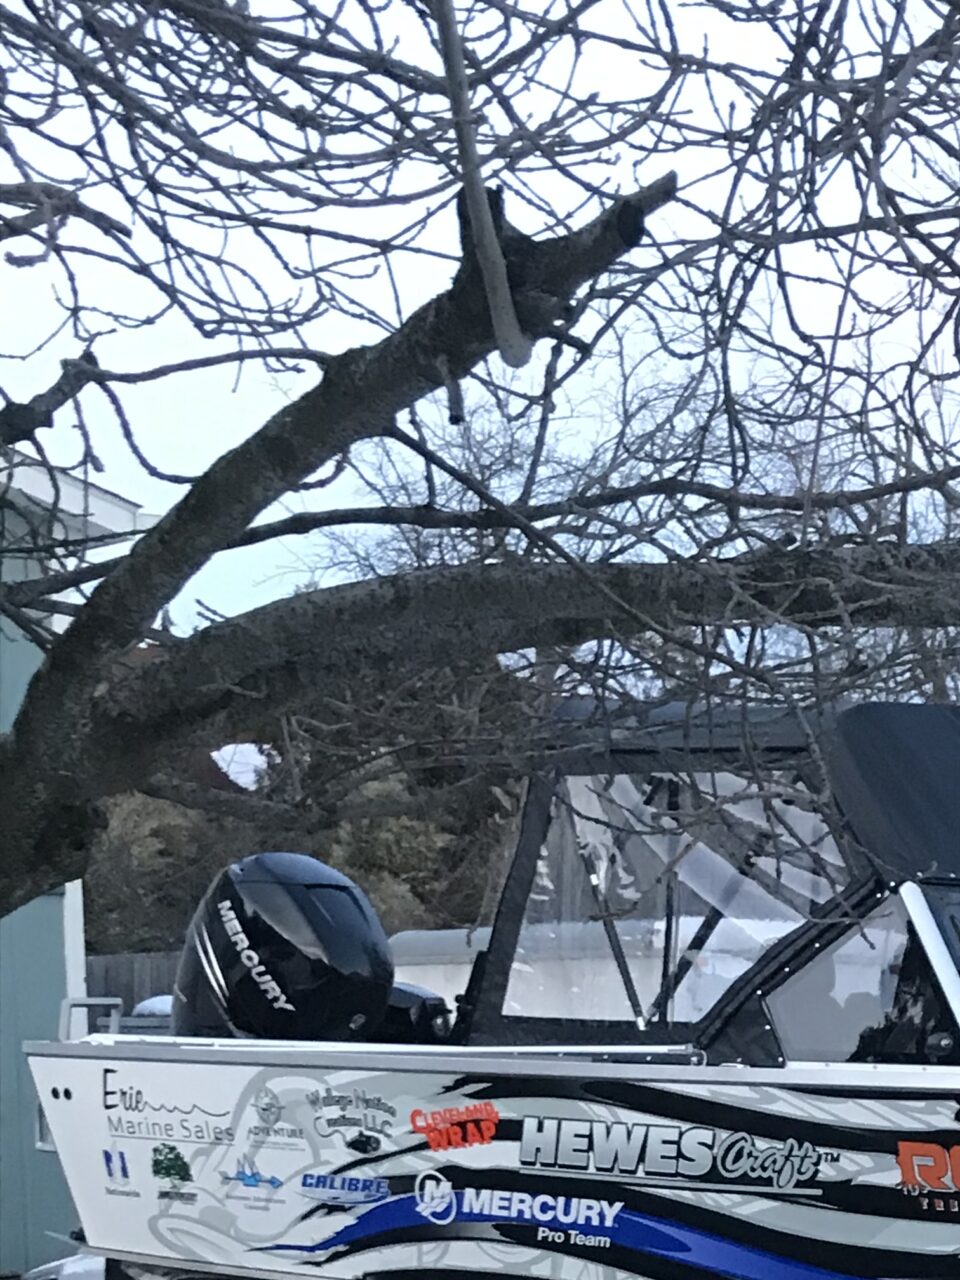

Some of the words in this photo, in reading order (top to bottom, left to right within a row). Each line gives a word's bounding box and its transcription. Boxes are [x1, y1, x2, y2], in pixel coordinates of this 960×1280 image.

[217, 899, 296, 1012] MERCURY
[107, 1116, 174, 1138] Marine
[180, 1119, 234, 1142] Sales
[426, 1120, 497, 1152] WRAP
[519, 1116, 716, 1177] HEWES
[301, 1173, 390, 1195] CALIBRE
[461, 1187, 625, 1227] MERCURY
[537, 1227, 565, 1243] Pro
[567, 1230, 611, 1248] Team
